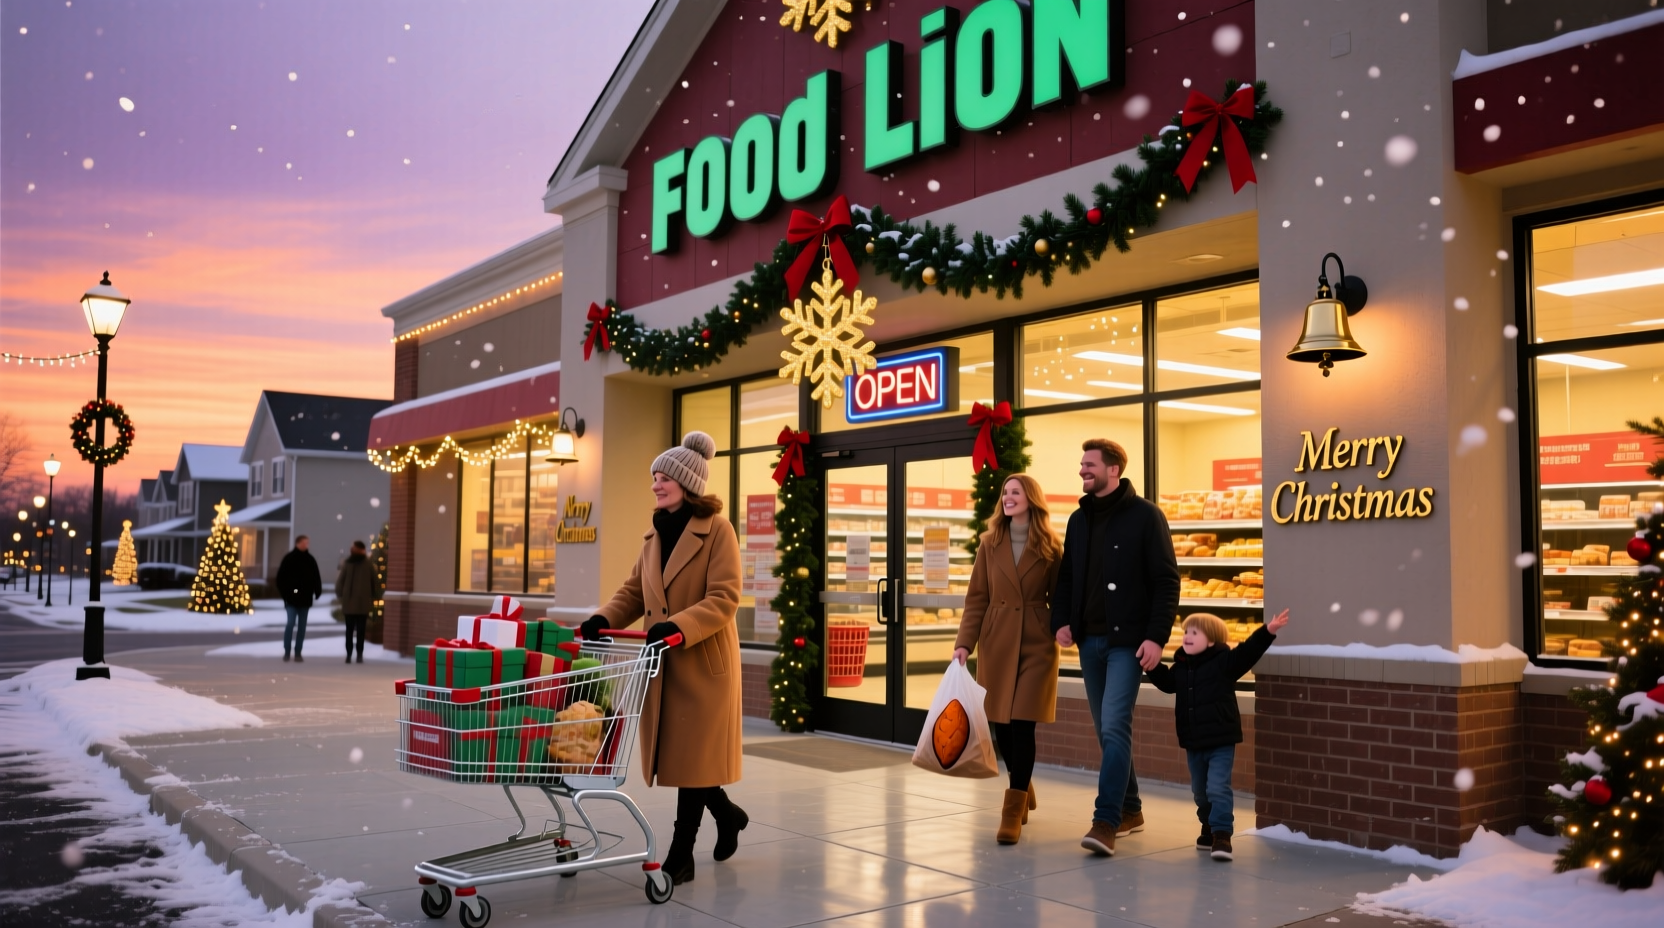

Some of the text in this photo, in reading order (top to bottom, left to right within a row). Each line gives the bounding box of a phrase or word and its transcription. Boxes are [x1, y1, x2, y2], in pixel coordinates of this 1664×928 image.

[855, 363, 936, 409] OPEN
[1294, 427, 1403, 479] Merry
[1270, 480, 1434, 524] Christmas
